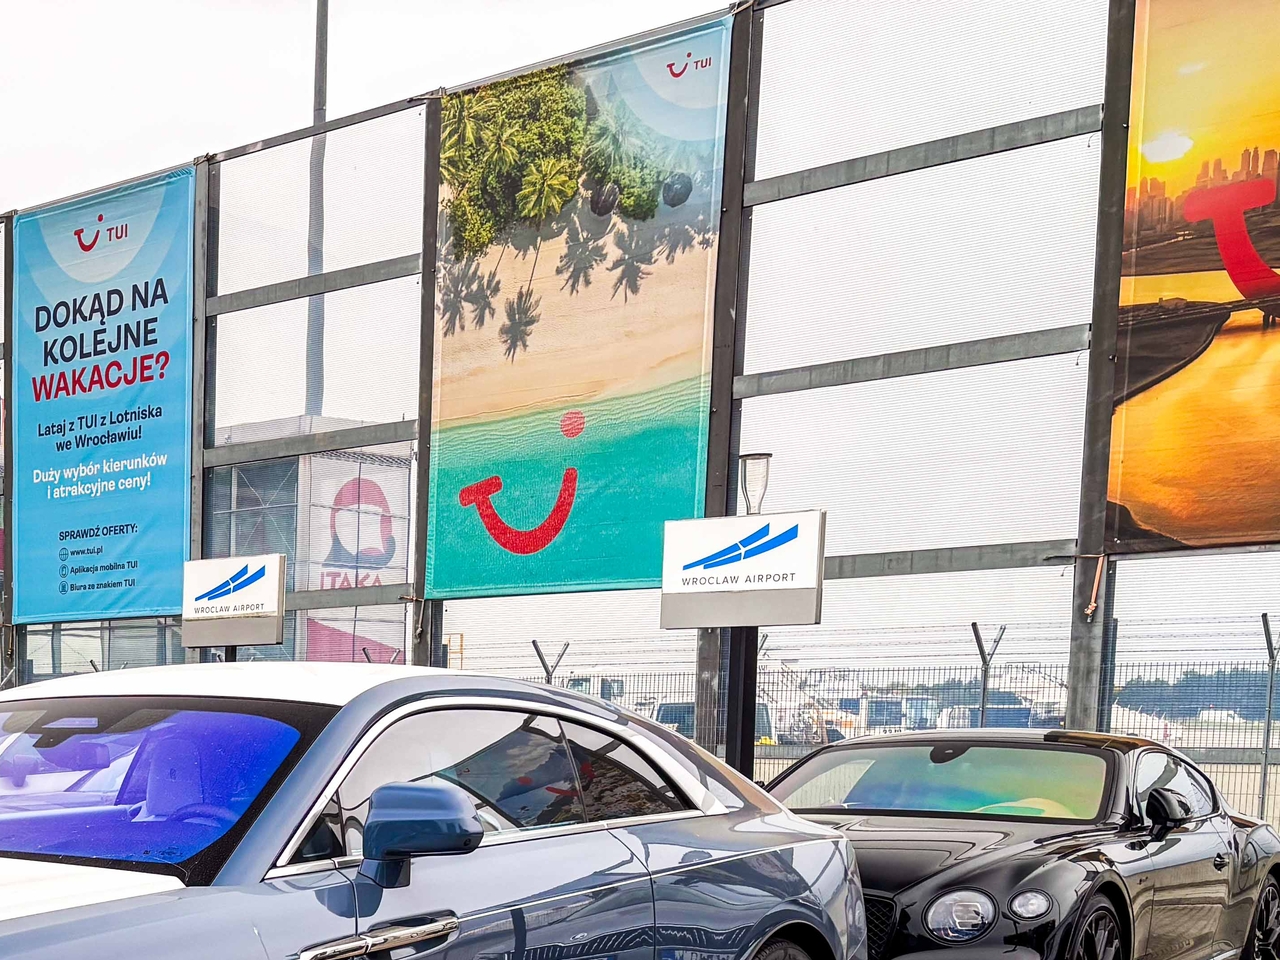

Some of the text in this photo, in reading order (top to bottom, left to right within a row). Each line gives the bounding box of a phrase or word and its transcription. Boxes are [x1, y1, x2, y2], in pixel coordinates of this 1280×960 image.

[693, 56, 712, 71] TUI
[106, 223, 128, 242] TUI
[35, 277, 169, 333] DOKĄD NA
[43, 317, 158, 367] KOLEJNE
[31, 350, 170, 402] WAKACJE?
[37, 404, 162, 438] Lataj z TUI z Lotniska
[56, 425, 142, 452] we Wrocławiu!
[32, 452, 168, 484] Duży wybór kierunków
[46, 471, 151, 499] i atrakcyjne ceny!
[58, 523, 138, 542] SPRAWDŹ OFERTY:
[70, 546, 103, 557] www.tui.pl
[70, 560, 138, 576] Aplikacja mobilna TUI
[70, 578, 136, 592] Biura ze znakiem TUI
[682, 572, 796, 586] WROCLAW AIRPORT
[194, 602, 265, 614] WROCLAW AIRPORT
